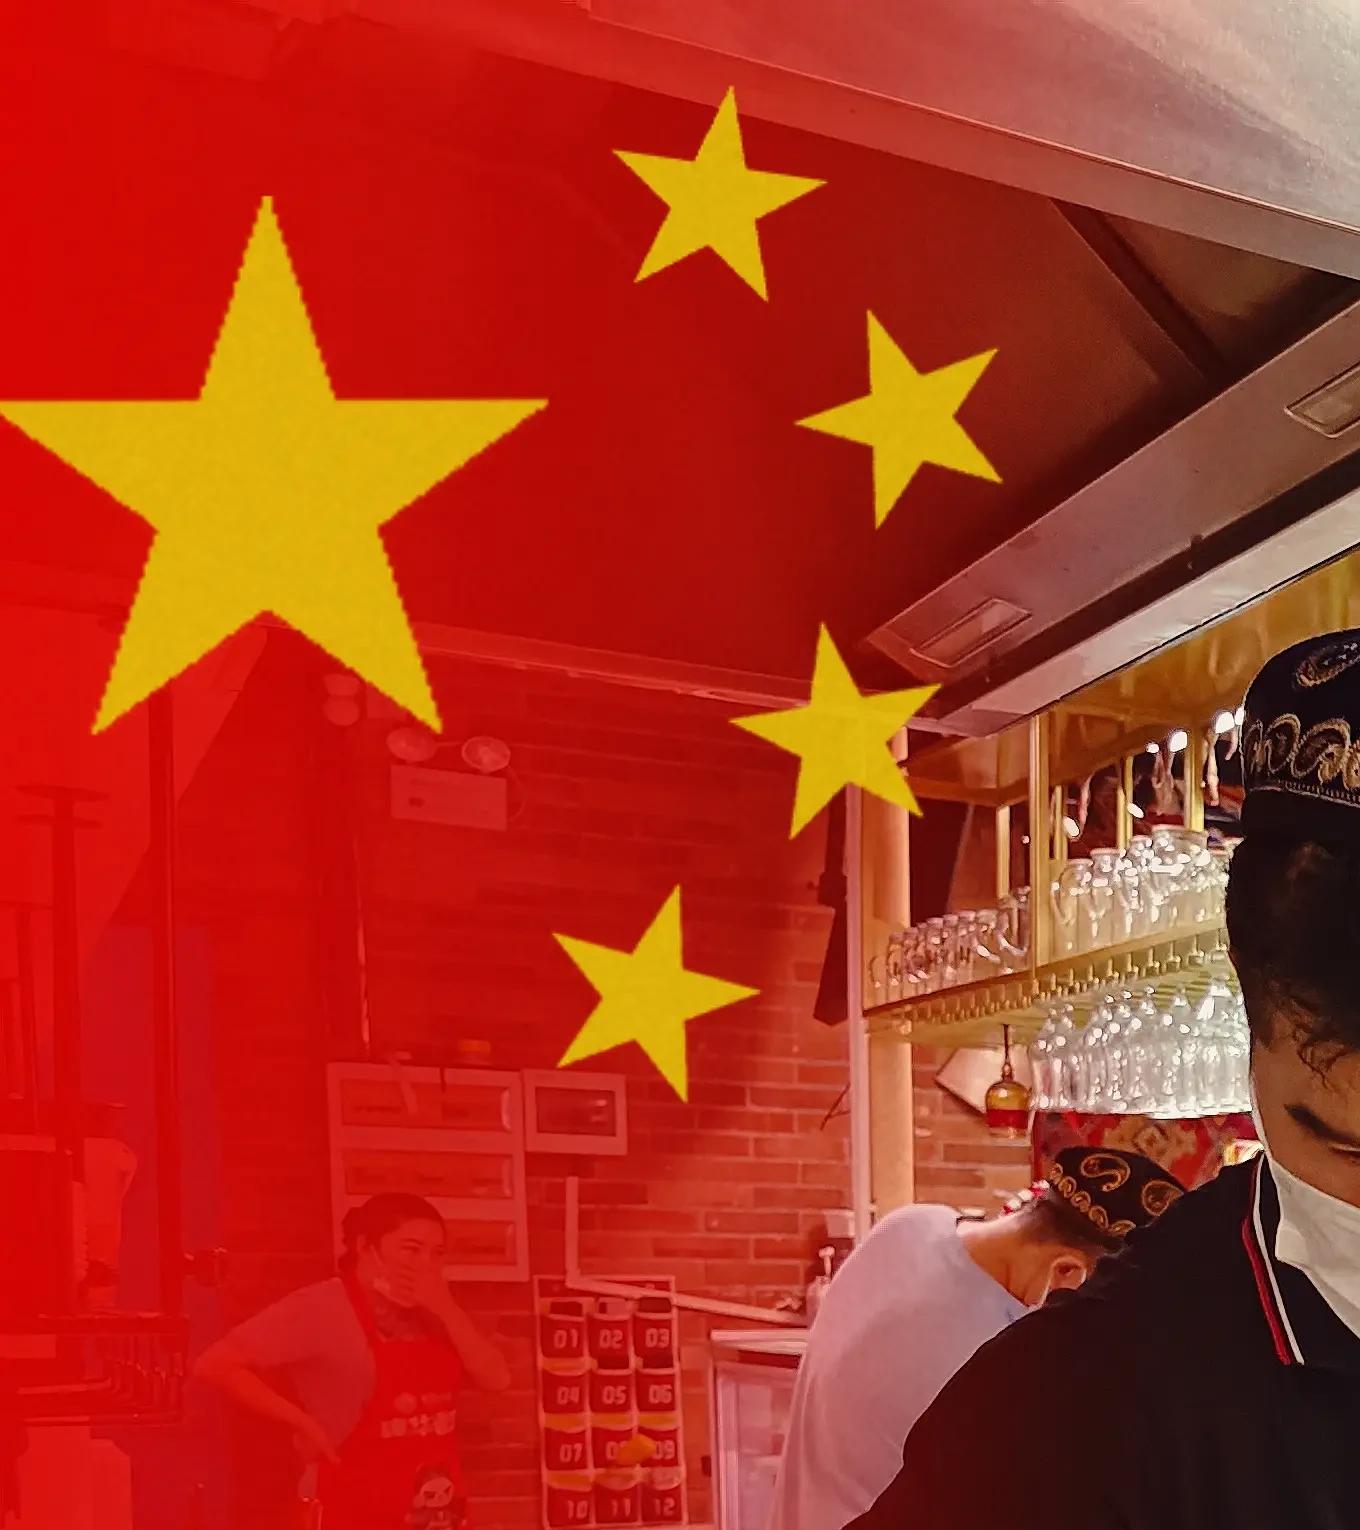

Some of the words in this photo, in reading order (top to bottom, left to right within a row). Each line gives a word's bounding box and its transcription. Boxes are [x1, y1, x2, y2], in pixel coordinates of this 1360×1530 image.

[553, 1329, 580, 1349] 01
[600, 1329, 624, 1349] 02
[645, 1328, 670, 1349] 03
[556, 1385, 580, 1405] 04
[602, 1385, 627, 1405] 05
[648, 1384, 673, 1404] 06
[560, 1443, 583, 1463] 07
[566, 1500, 589, 1520] 10
[654, 1497, 677, 1517] 12
